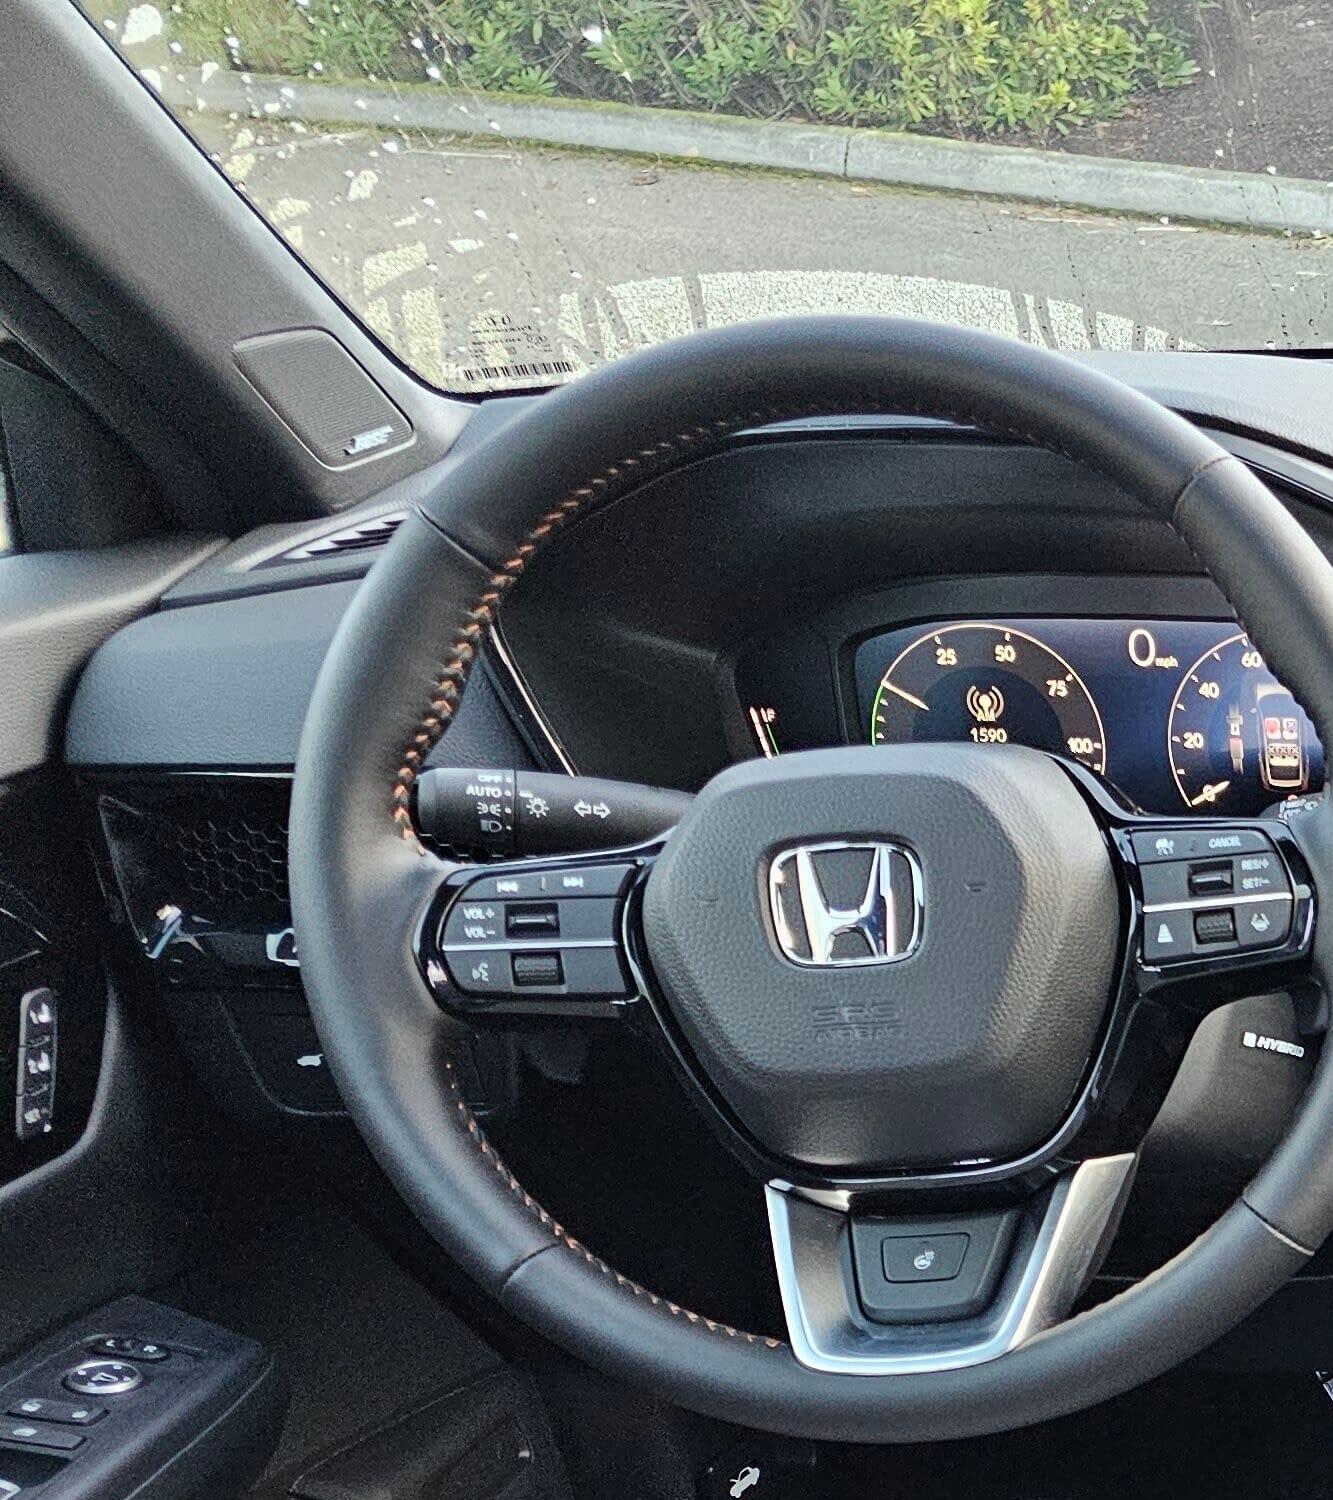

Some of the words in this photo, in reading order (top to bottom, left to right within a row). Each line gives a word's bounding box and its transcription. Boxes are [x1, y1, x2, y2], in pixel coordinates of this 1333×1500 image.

[995, 645, 1016, 663] 50
[1128, 629, 1155, 667] 0
[936, 648, 957, 666] 25
[1241, 651, 1262, 668] 60
[1046, 680, 1068, 698] 75
[1199, 682, 1220, 699] 40
[977, 712, 996, 722] AM
[970, 728, 1007, 744] 1590
[1183, 732, 1204, 749] 20
[1067, 738, 1093, 754] 100
[466, 785, 502, 798] AUTO
[1208, 835, 1242, 849] CANCEL
